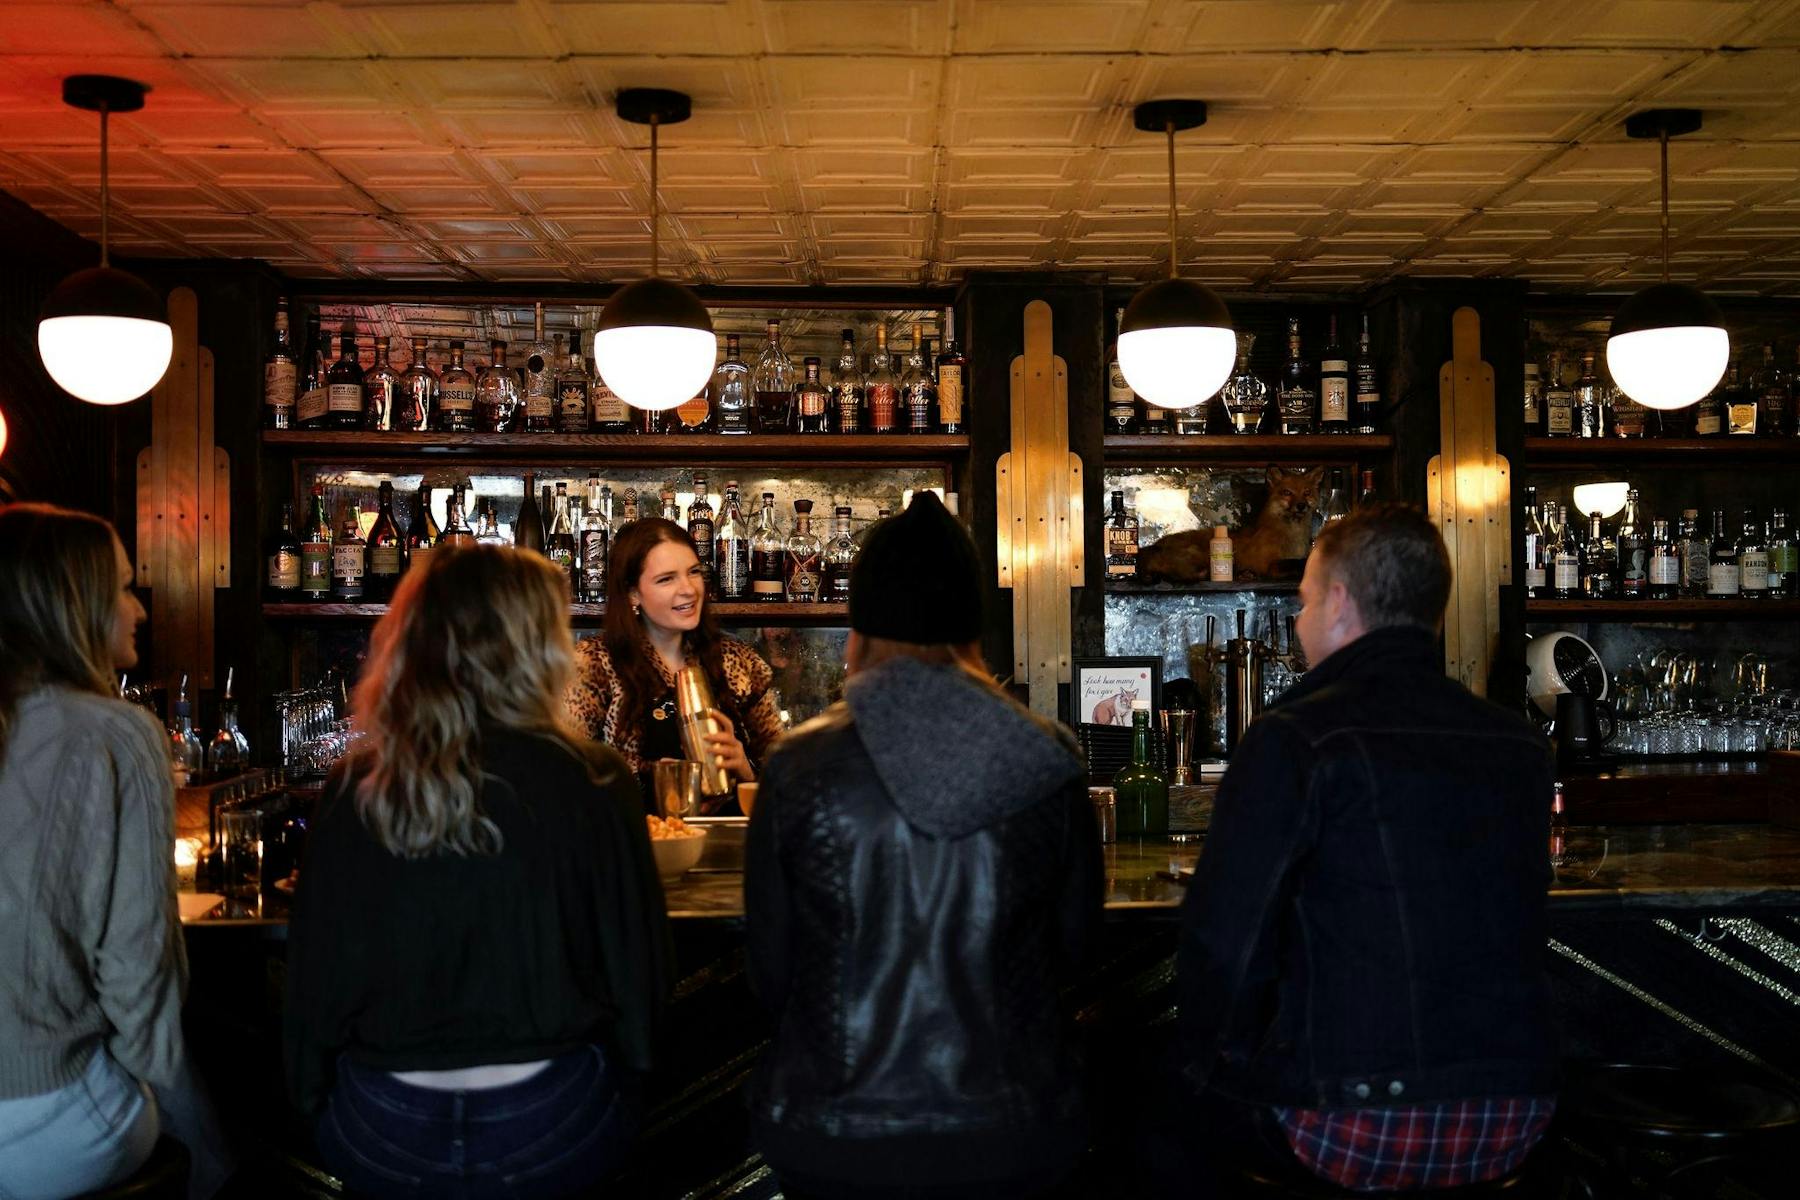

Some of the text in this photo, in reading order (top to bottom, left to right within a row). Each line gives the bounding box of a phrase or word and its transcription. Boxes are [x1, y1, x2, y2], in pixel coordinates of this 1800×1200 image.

[1109, 530, 1132, 541] KNOB
[335, 568, 362, 576] BRUTTO
[800, 577, 811, 585] XO
[1116, 679, 1136, 688] many
